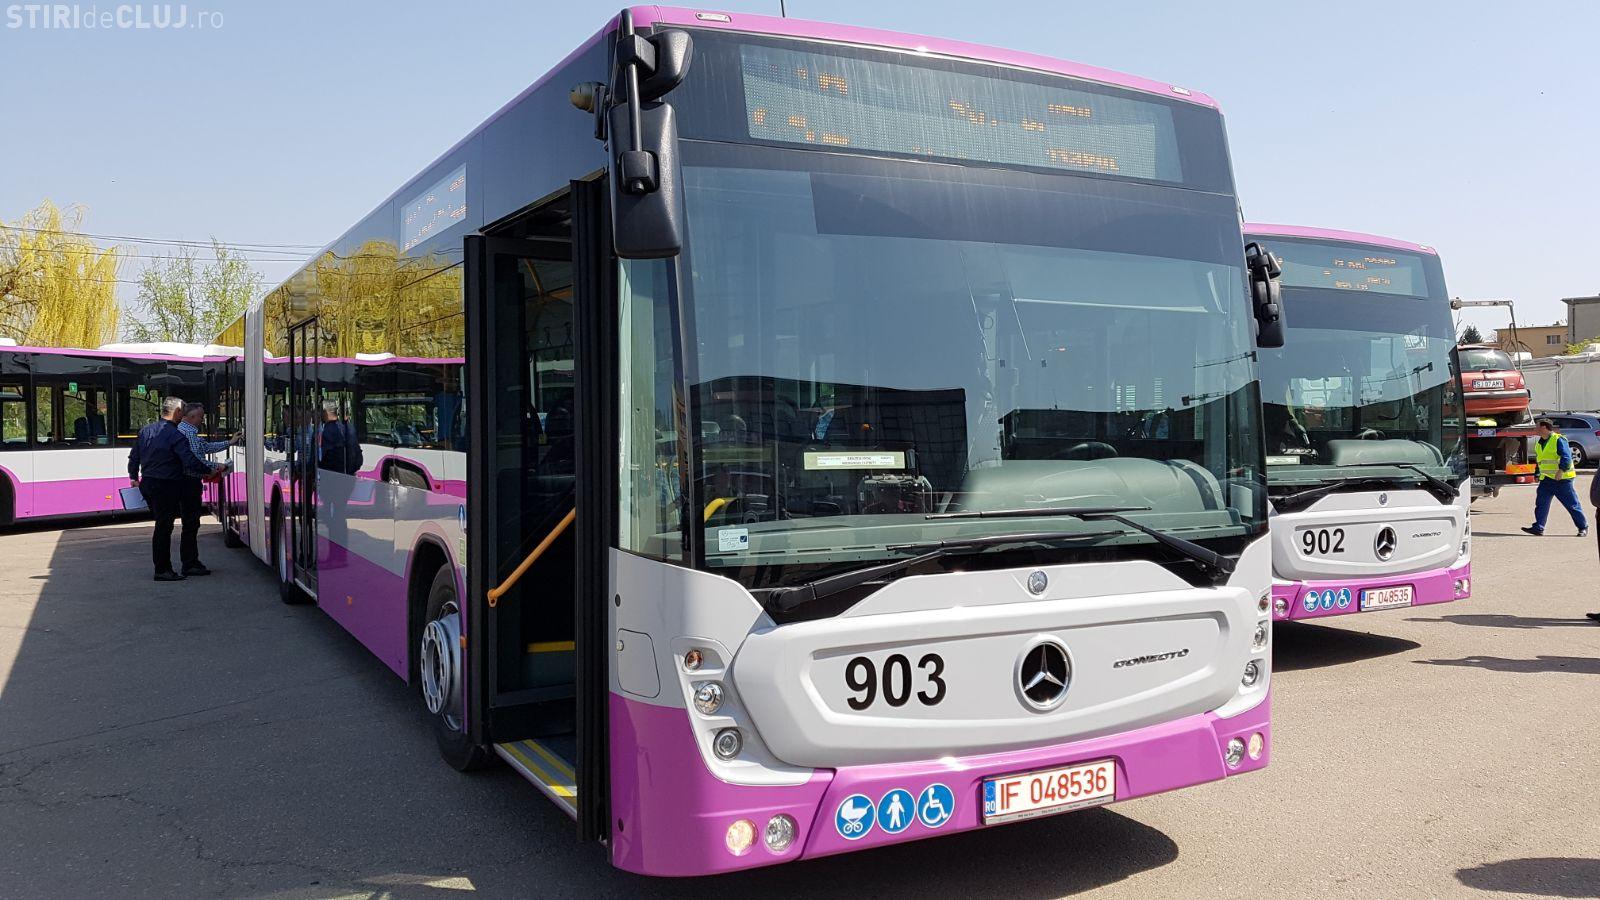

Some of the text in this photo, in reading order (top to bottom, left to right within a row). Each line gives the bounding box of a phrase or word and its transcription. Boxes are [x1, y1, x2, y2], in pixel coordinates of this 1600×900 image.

[1302, 528, 1345, 555] 902
[1366, 588, 1409, 606] IF 048535
[1113, 648, 1190, 668] CONECTO
[845, 653, 947, 711] 903
[1000, 781, 1021, 810] IF
[1030, 766, 1107, 804] 048536
[985, 800, 996, 813] RO
